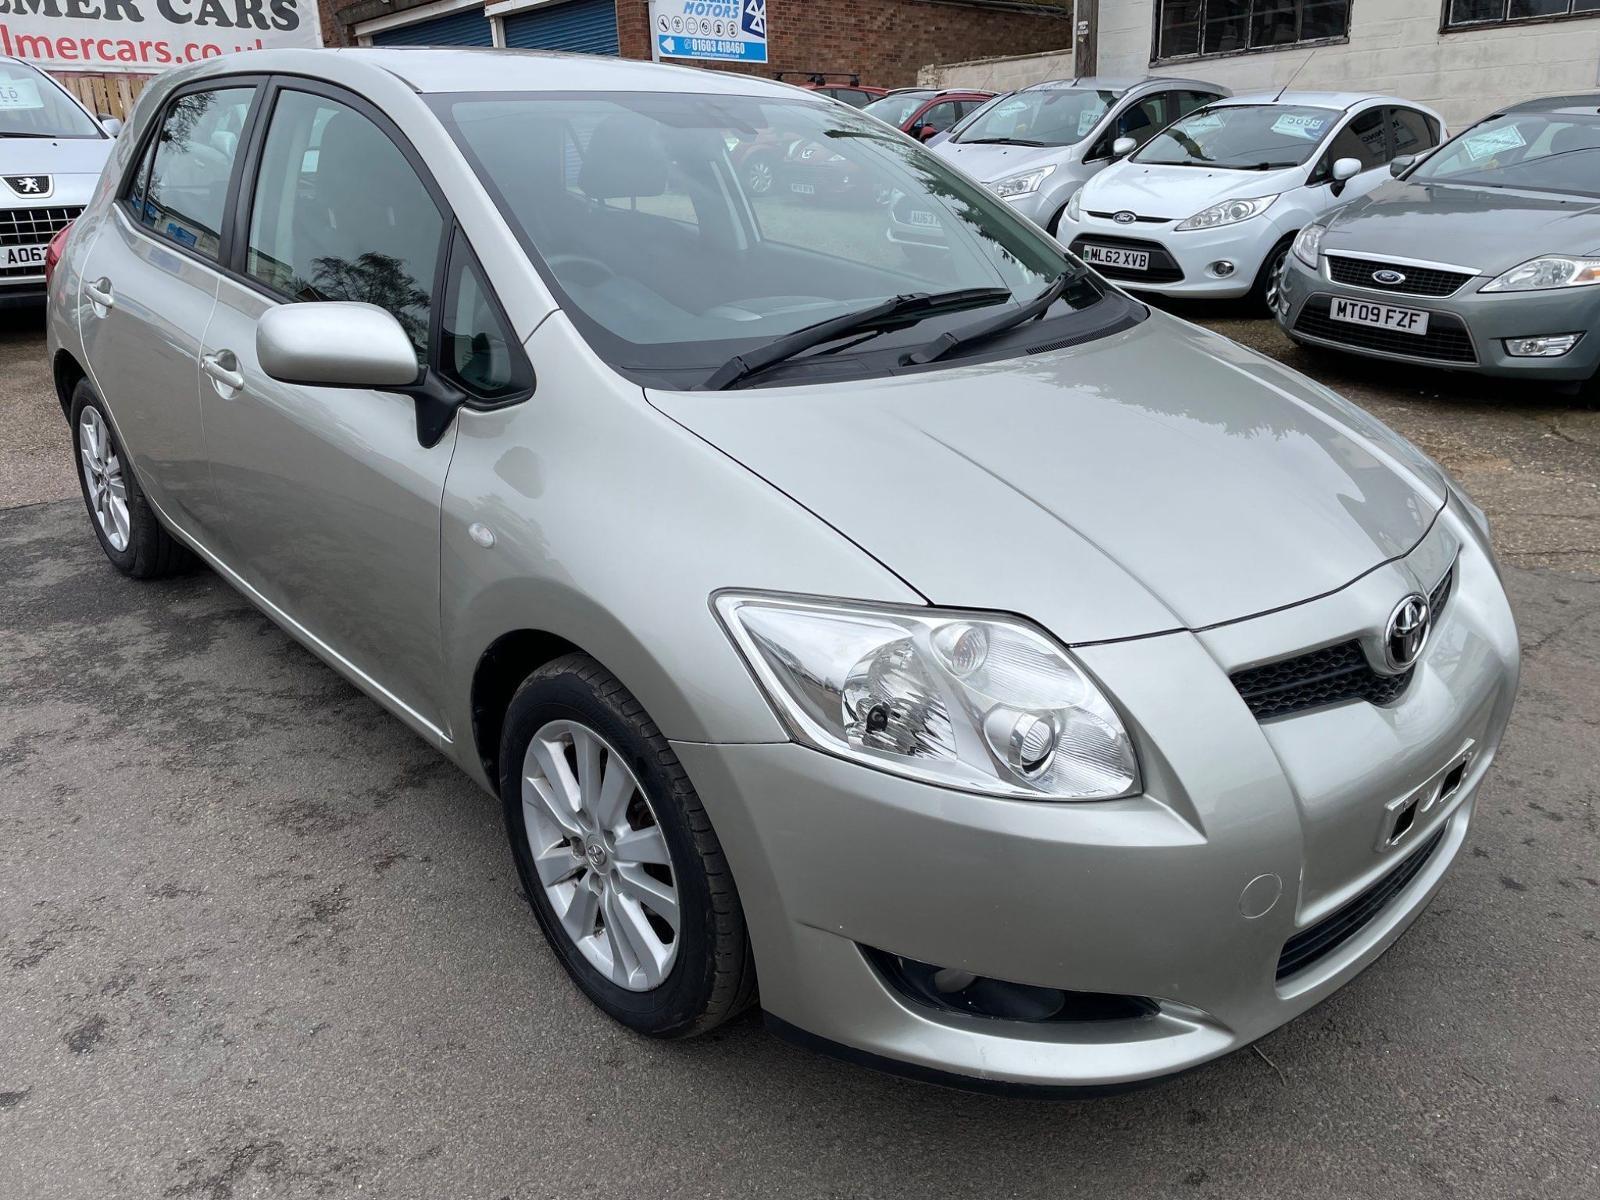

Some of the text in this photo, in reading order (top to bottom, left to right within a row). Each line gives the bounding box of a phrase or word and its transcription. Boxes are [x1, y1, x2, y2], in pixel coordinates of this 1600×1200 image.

[156, 0, 300, 31] CARS
[683, 1, 740, 19] MOTORS
[692, 38, 716, 52] 01603
[1090, 247, 1147, 268] ML62 XVB
[1336, 301, 1420, 329] MT09 FZF
